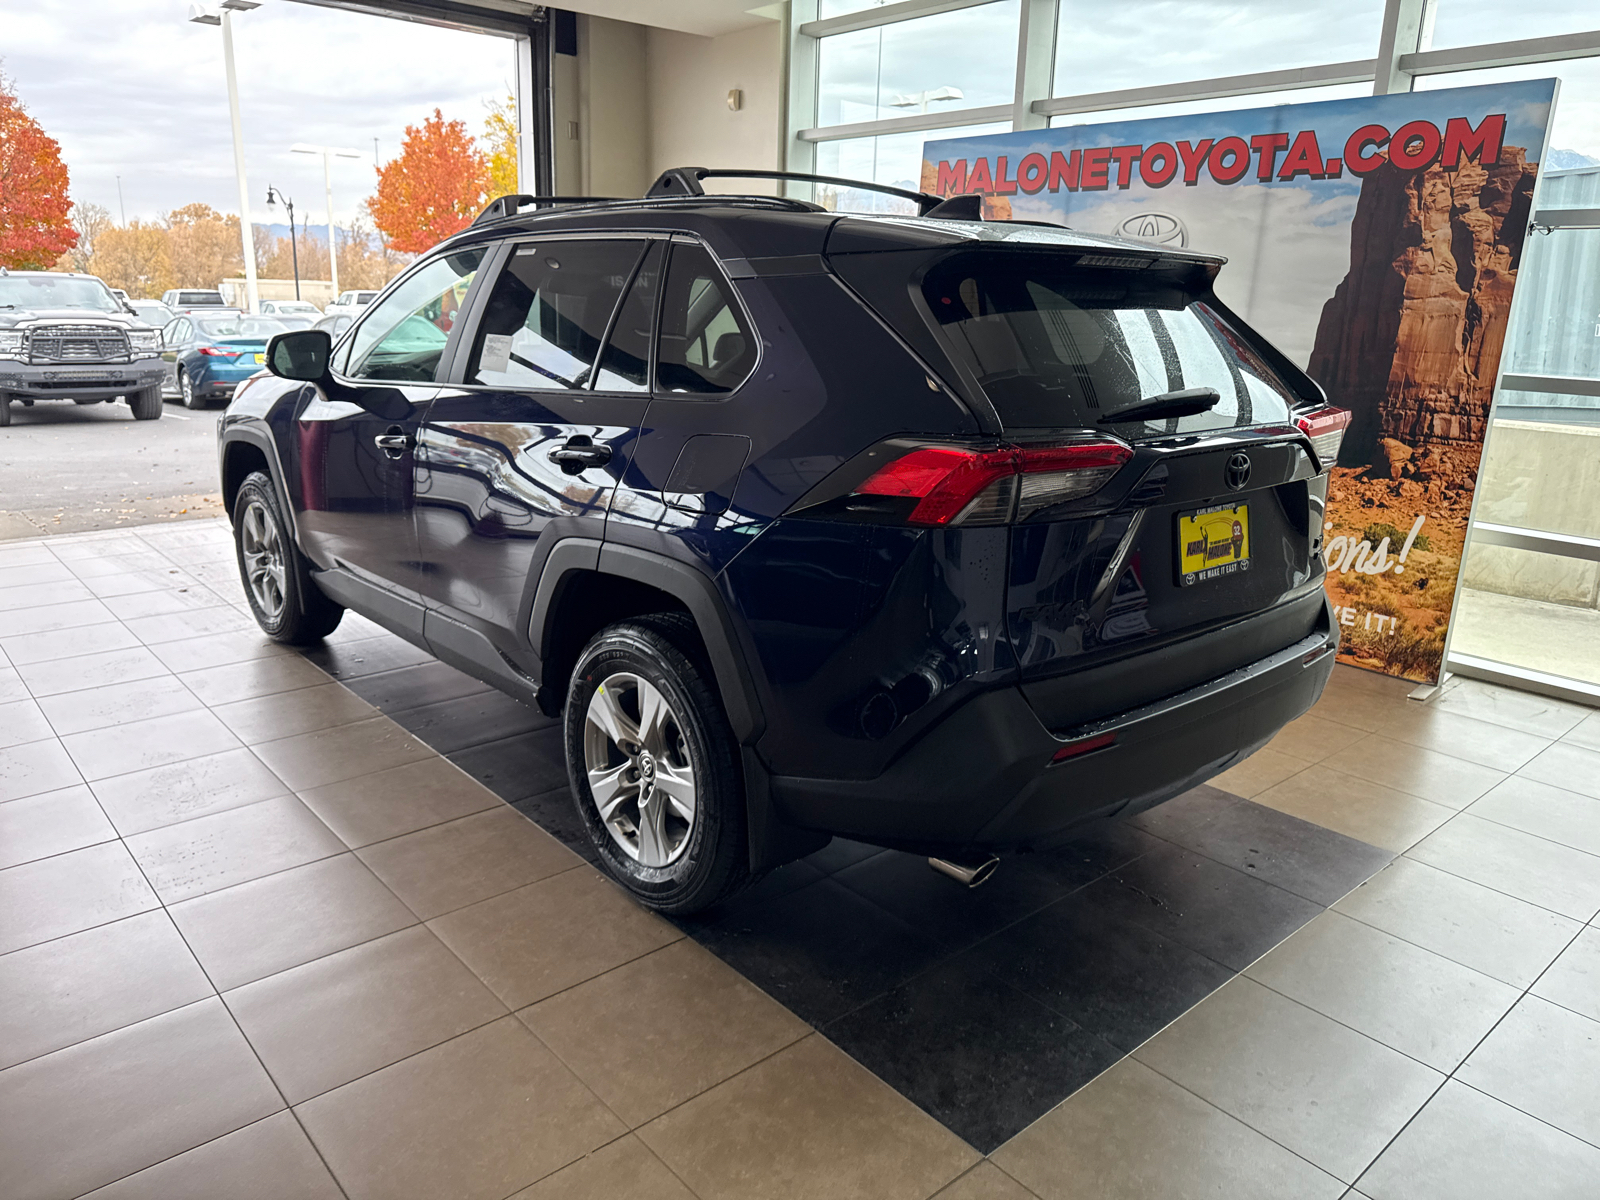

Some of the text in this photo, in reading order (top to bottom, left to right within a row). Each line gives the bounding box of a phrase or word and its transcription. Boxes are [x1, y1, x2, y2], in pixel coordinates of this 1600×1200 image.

[935, 113, 1508, 197] MALONETOYOTA.COM
[1233, 525, 1241, 536] 32
[1186, 539, 1204, 557] KARL
[1207, 542, 1232, 561] MALONE
[1324, 515, 1426, 575] ons!
[1198, 563, 1237, 581] WE MAKE IT EASY
[1365, 612, 1397, 636] IT!
